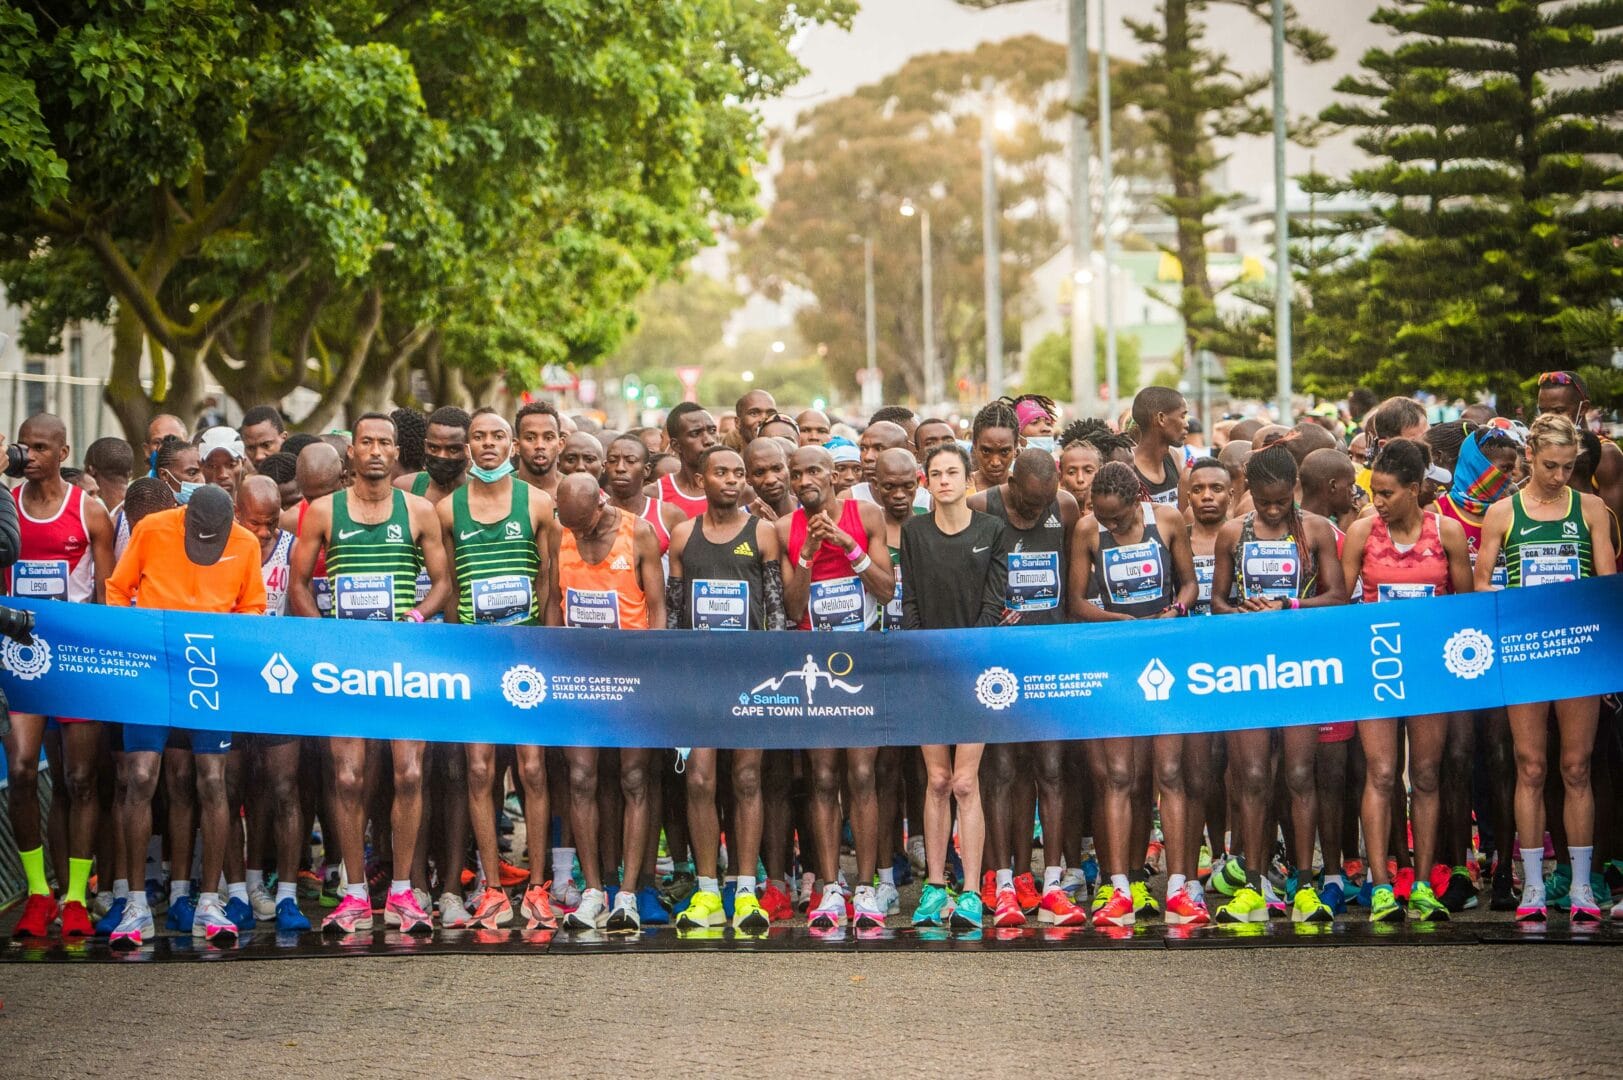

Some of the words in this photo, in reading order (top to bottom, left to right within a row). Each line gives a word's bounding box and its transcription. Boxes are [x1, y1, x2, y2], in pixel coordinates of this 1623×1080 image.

[1121, 549, 1153, 560] Sanlam
[1260, 547, 1292, 555] Sanlam
[1543, 547, 1557, 556] 2021
[1022, 559, 1051, 567] Sanlam
[1540, 563, 1572, 571] Sanlam
[28, 567, 60, 575] Sanlam
[1126, 565, 1141, 577] Lucy
[266, 566, 288, 592] 40
[353, 580, 386, 589] Sanlam
[490, 581, 522, 590] Sanlam
[825, 584, 856, 594] Sanlam
[709, 587, 741, 595] Sanlam
[1396, 589, 1427, 598] Sanlam
[579, 597, 610, 605] Sanlam
[1501, 634, 1522, 644] CITY
[1525, 632, 1539, 641] OF
[1541, 628, 1567, 639] CAPE
[1569, 624, 1600, 635] TOWN
[1501, 642, 1540, 653] ISIXEKO
[1543, 635, 1593, 649] SASEKAPA
[57, 644, 79, 653] CITY
[99, 649, 125, 658] CAPE
[127, 652, 157, 661] TOWN
[1502, 653, 1527, 663] STAD
[1529, 646, 1581, 660] KAAPSTAD
[58, 654, 98, 664] ISIXEKO
[101, 657, 151, 669] SASEKAPA
[1370, 621, 1405, 702] 2021
[59, 663, 84, 673] STAD
[87, 666, 138, 677] KAAPSTAD
[184, 632, 220, 711] 2021
[1187, 653, 1344, 695] Sanlam
[311, 661, 471, 700] Sanlam
[551, 676, 571, 684] CITY
[573, 676, 586, 684] OF
[588, 677, 612, 685] CAPE
[613, 677, 640, 685] TOWN
[1023, 675, 1042, 683] CITY
[1044, 674, 1056, 682] OF
[1058, 673, 1081, 681] CAPE
[1082, 671, 1109, 680] TOWN
[552, 684, 587, 692] ISIXEKO
[589, 685, 635, 693] SASEKAPA
[1023, 683, 1057, 691] ISIXEKO
[1059, 681, 1103, 689] SASEKAPA
[552, 692, 575, 700] STAD
[577, 693, 623, 701] KAAPSTAD
[753, 693, 800, 704] Sanlam
[1024, 691, 1046, 699] STAD
[1047, 689, 1092, 698] KAAPSTAD
[732, 706, 764, 716] CAPE
[767, 706, 803, 716] TOWN
[807, 706, 874, 716] MARATHON
